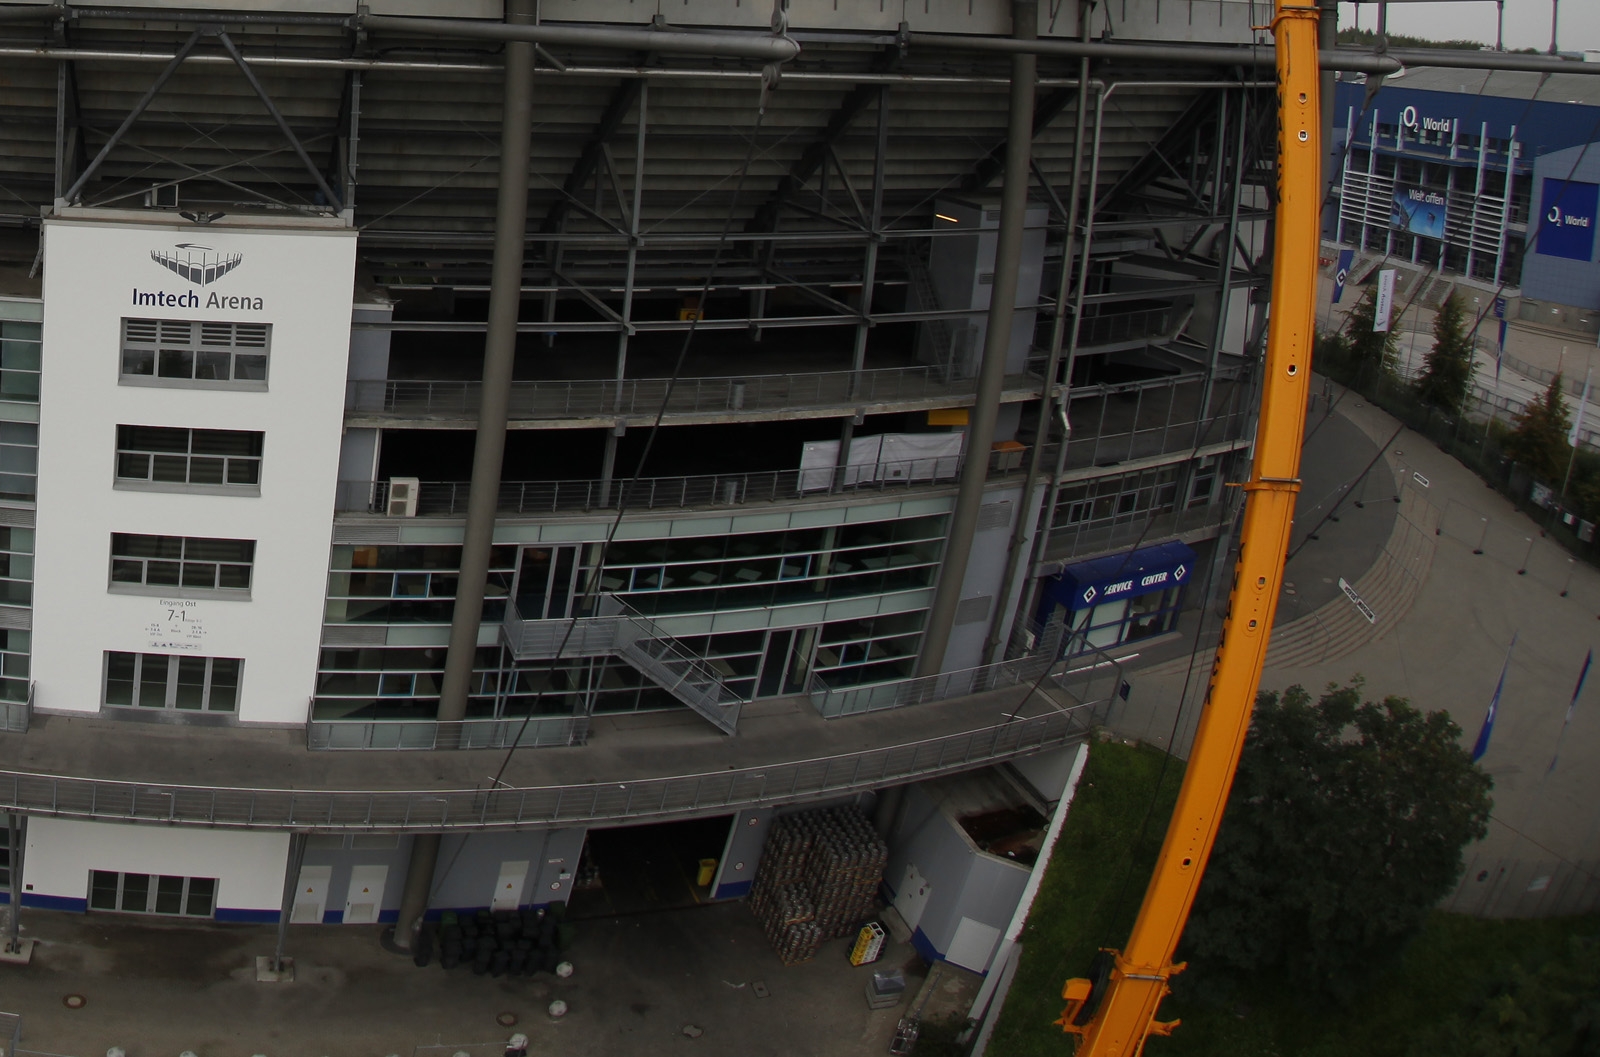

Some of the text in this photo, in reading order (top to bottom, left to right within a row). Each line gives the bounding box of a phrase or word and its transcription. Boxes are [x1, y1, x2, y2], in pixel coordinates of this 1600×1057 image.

[1423, 117, 1450, 132] World
[1425, 192, 1444, 206] offen
[1565, 215, 1588, 227] World
[132, 288, 264, 311] Imtech Arena
[1141, 572, 1168, 586] CENTER
[159, 599, 184, 607] Eingang
[167, 609, 186, 622] 7-1
